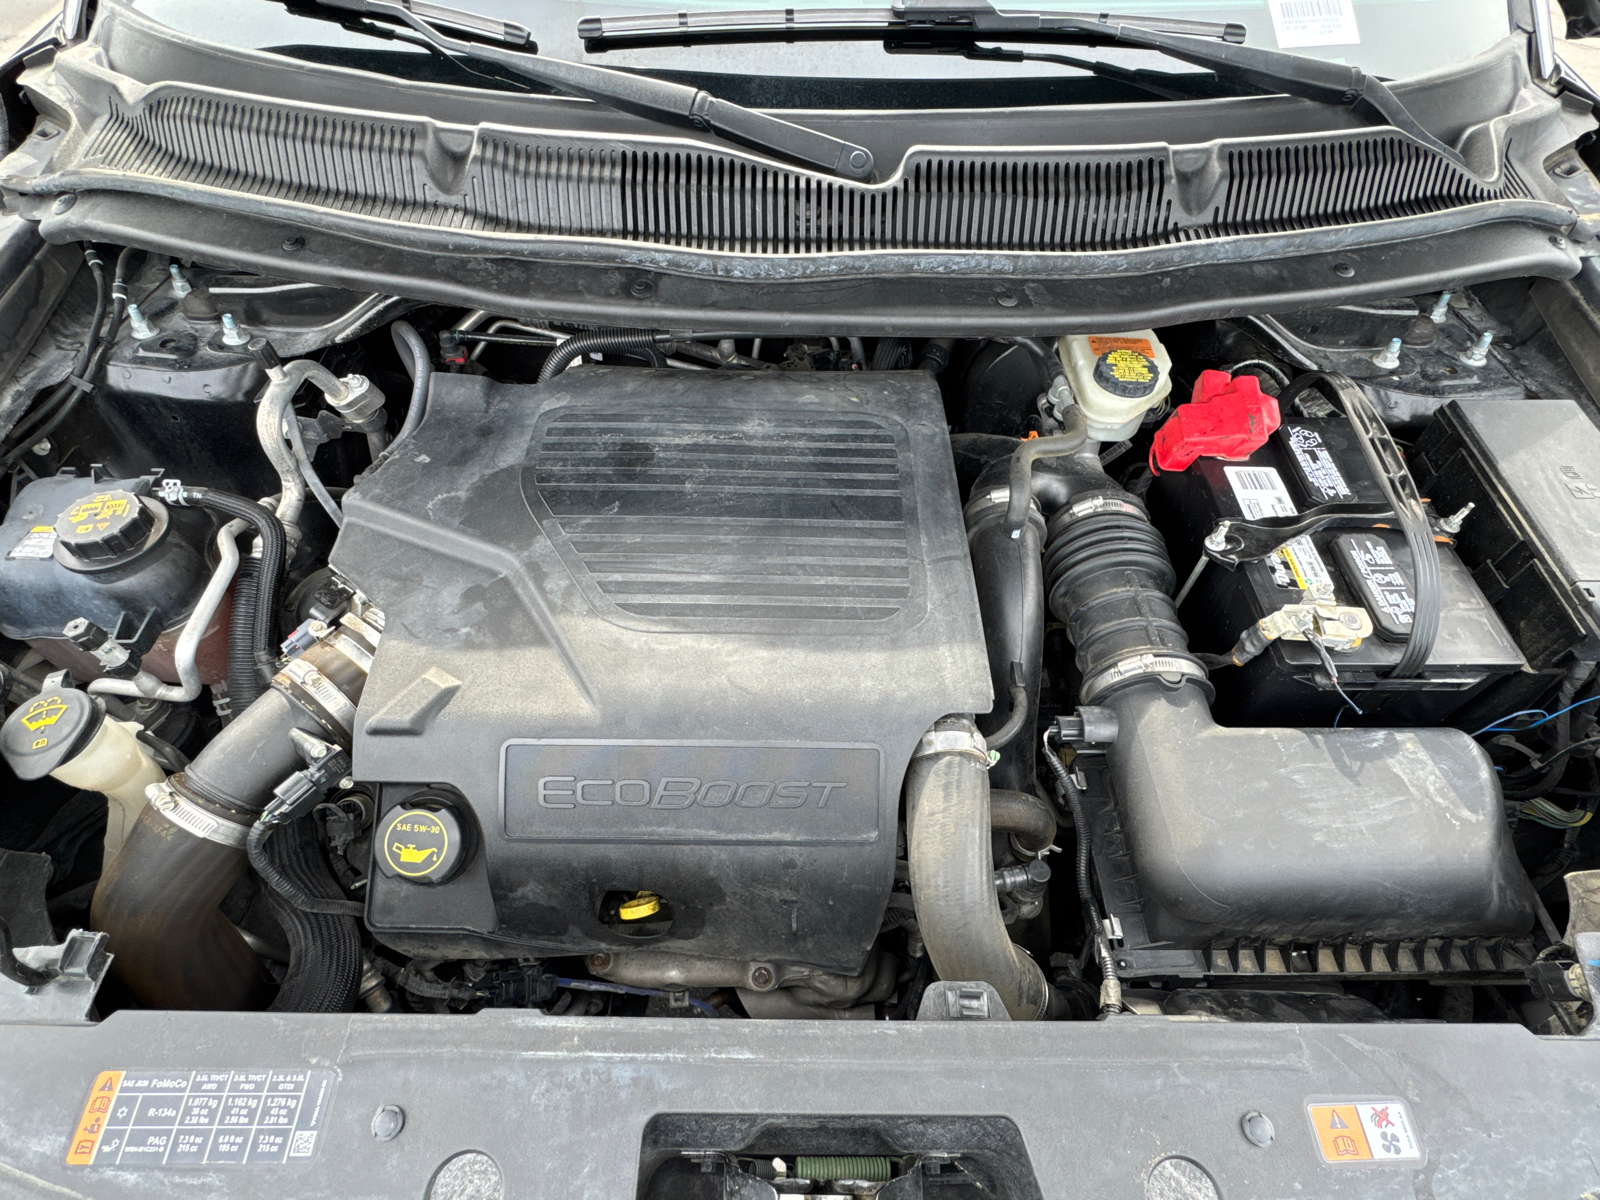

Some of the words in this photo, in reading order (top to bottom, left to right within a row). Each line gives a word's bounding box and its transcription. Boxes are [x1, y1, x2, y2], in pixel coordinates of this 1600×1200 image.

[396, 823, 412, 831] SAE
[413, 824, 440, 834] 5W-30
[150, 1079, 188, 1088] FoMoCo
[188, 1097, 208, 1106] 1.077
[208, 1098, 219, 1108] kg
[227, 1098, 248, 1106] 1.162
[247, 1098, 258, 1109] kg
[267, 1098, 287, 1106] 1.276
[287, 1098, 297, 1109] kg
[148, 1108, 177, 1117] R-134a
[198, 1116, 209, 1124] lbs
[238, 1116, 249, 1124] lbs
[278, 1116, 289, 1124] lbs
[147, 1136, 168, 1145] PAG
[178, 1135, 189, 1143] 7.3
[258, 1135, 269, 1143] 7.3
[177, 1144, 190, 1152] 215
[258, 1144, 270, 1152] 215
